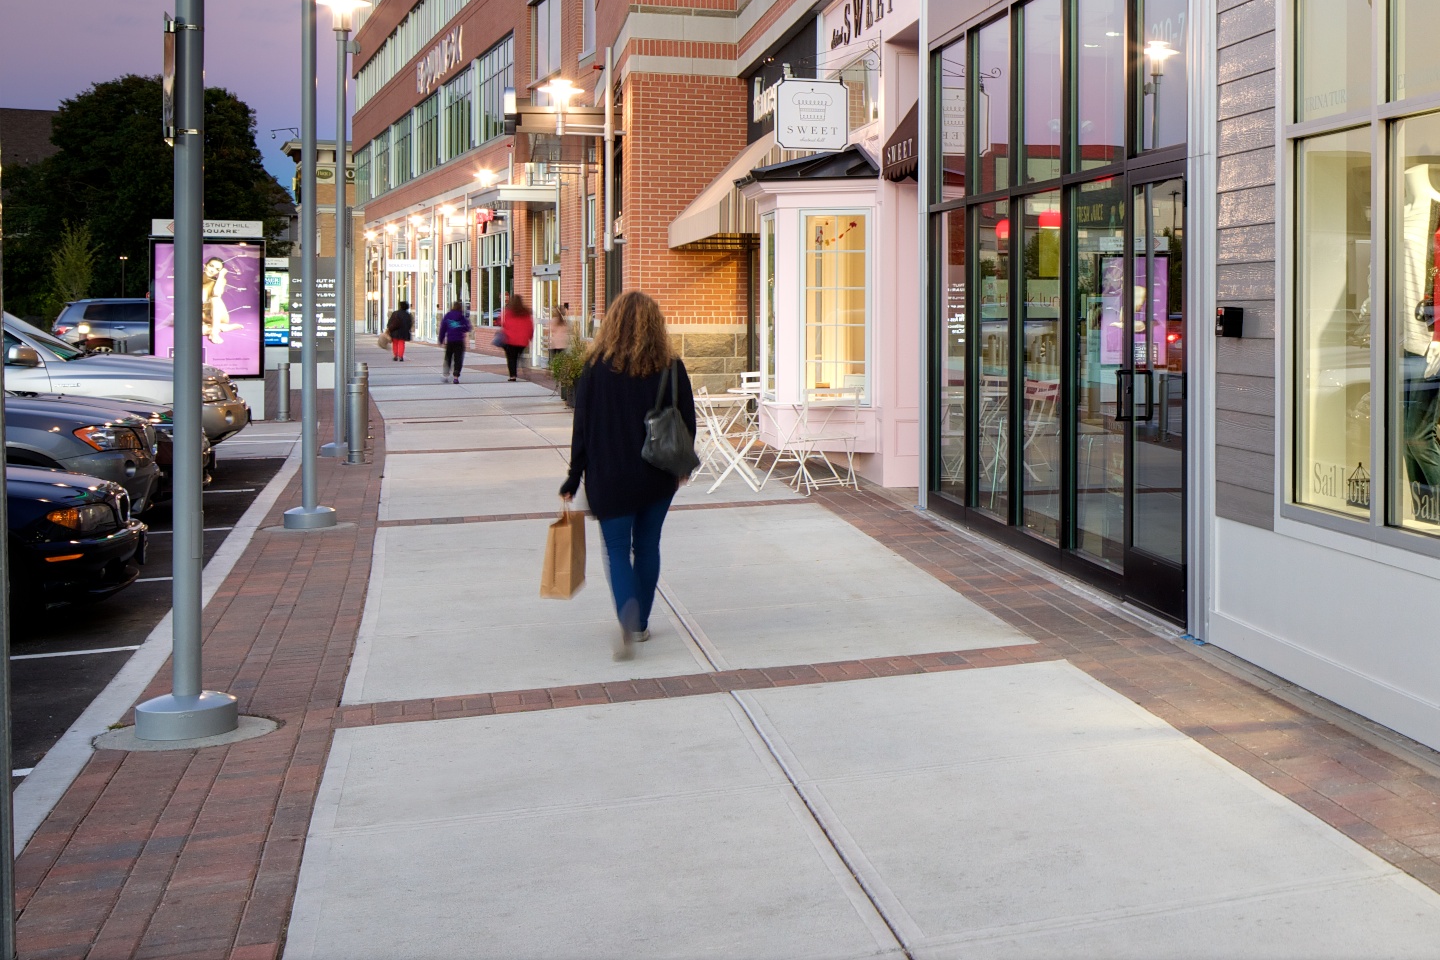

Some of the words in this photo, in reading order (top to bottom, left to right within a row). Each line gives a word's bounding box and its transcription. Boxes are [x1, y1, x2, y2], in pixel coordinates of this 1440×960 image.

[1329, 88, 1348, 107] TUR
[786, 125, 839, 136] SWEET
[887, 138, 913, 165] SWEET
[1313, 462, 1337, 499] Sail
[1411, 480, 1440, 522] Sail
